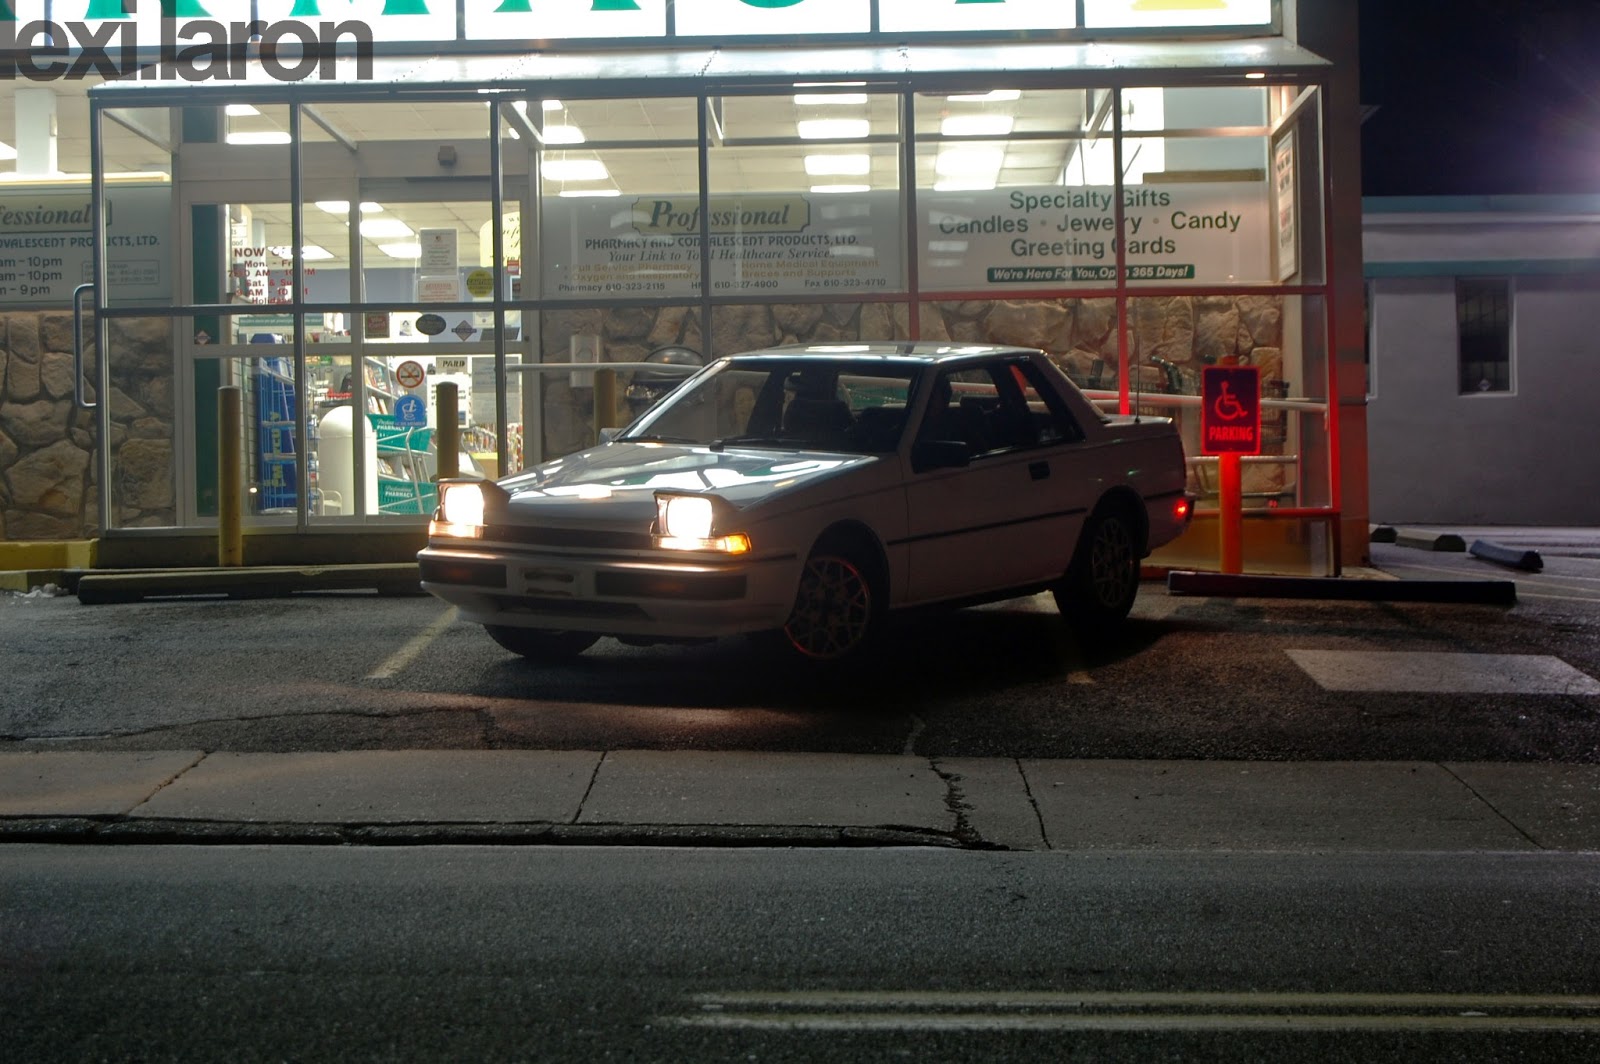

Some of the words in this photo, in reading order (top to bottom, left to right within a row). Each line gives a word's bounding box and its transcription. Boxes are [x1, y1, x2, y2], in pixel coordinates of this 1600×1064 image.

[1010, 190, 1112, 212] Specialty
[1122, 188, 1171, 207] Gifts
[649, 200, 790, 231] Profssional
[939, 215, 1029, 234] Candles
[1057, 214, 1143, 235] Jewey
[1171, 211, 1241, 233] Candy
[585, 238, 647, 249] PHARMACY
[650, 237, 675, 248] AND
[678, 235, 764, 248] CONALESCENT
[1011, 238, 1105, 259] Greeting
[234, 247, 265, 257] NOW
[608, 251, 636, 262] Your
[639, 250, 666, 262] Link
[670, 251, 681, 261] to
[686, 250, 715, 261] Tol
[719, 248, 784, 260] Healthcare
[572, 263, 591, 273] ull
[741, 260, 773, 269] Home
[776, 260, 818, 269] Medical
[821, 259, 880, 269] Equipment
[782, 269, 805, 278] and
[807, 268, 857, 279] Supports
[993, 268, 1023, 280] We're
[1026, 268, 1053, 279] Here
[1054, 268, 1073, 279] For
[1075, 267, 1098, 280] You,
[1099, 267, 1130, 279] Opn
[1132, 266, 1154, 277] 365
[1156, 266, 1189, 278] Days!
[558, 284, 602, 292] Pharmacy
[605, 281, 665, 291] 610-323-2115
[823, 278, 886, 288] 610-323-4710
[1209, 426, 1253, 441] PARKING
